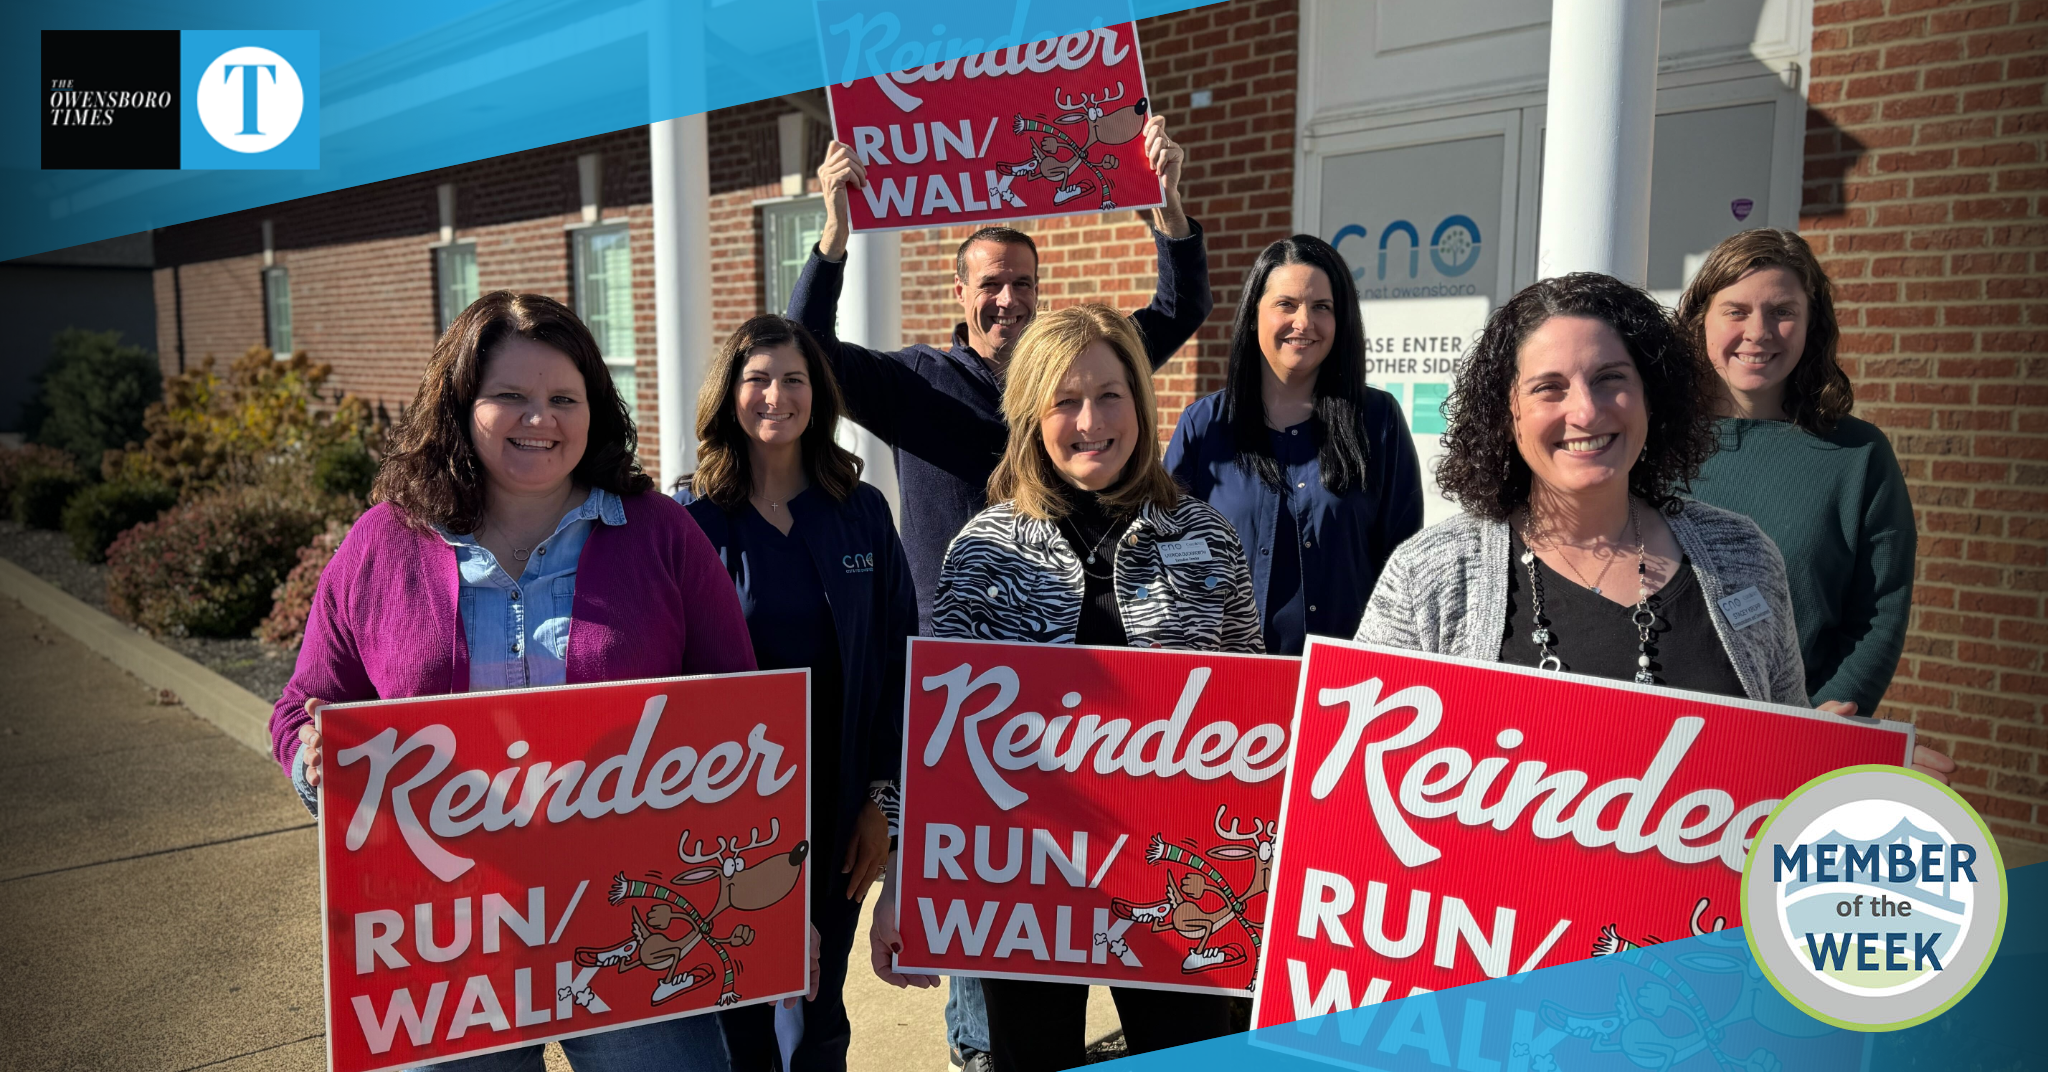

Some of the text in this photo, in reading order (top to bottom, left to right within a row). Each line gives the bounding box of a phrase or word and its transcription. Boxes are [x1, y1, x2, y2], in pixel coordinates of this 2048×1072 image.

[829, 0, 1130, 112] Reindeer
[852, 117, 999, 166] RUN/
[862, 169, 1027, 219] WALK
[1365, 284, 1389, 299] net
[1391, 281, 1477, 298] owensboro
[1365, 336, 1462, 353] ASE ENTER
[1365, 358, 1461, 374] OTHER SIDE
[922, 663, 1297, 810] Reindee
[1311, 676, 1784, 874] Reindee
[337, 694, 797, 882] Reindeer
[923, 822, 1129, 888] RUN/
[354, 880, 590, 975] RUN/
[917, 897, 1143, 967] WALK
[1297, 867, 1572, 984] RUN/
[351, 961, 611, 1055] WALK
